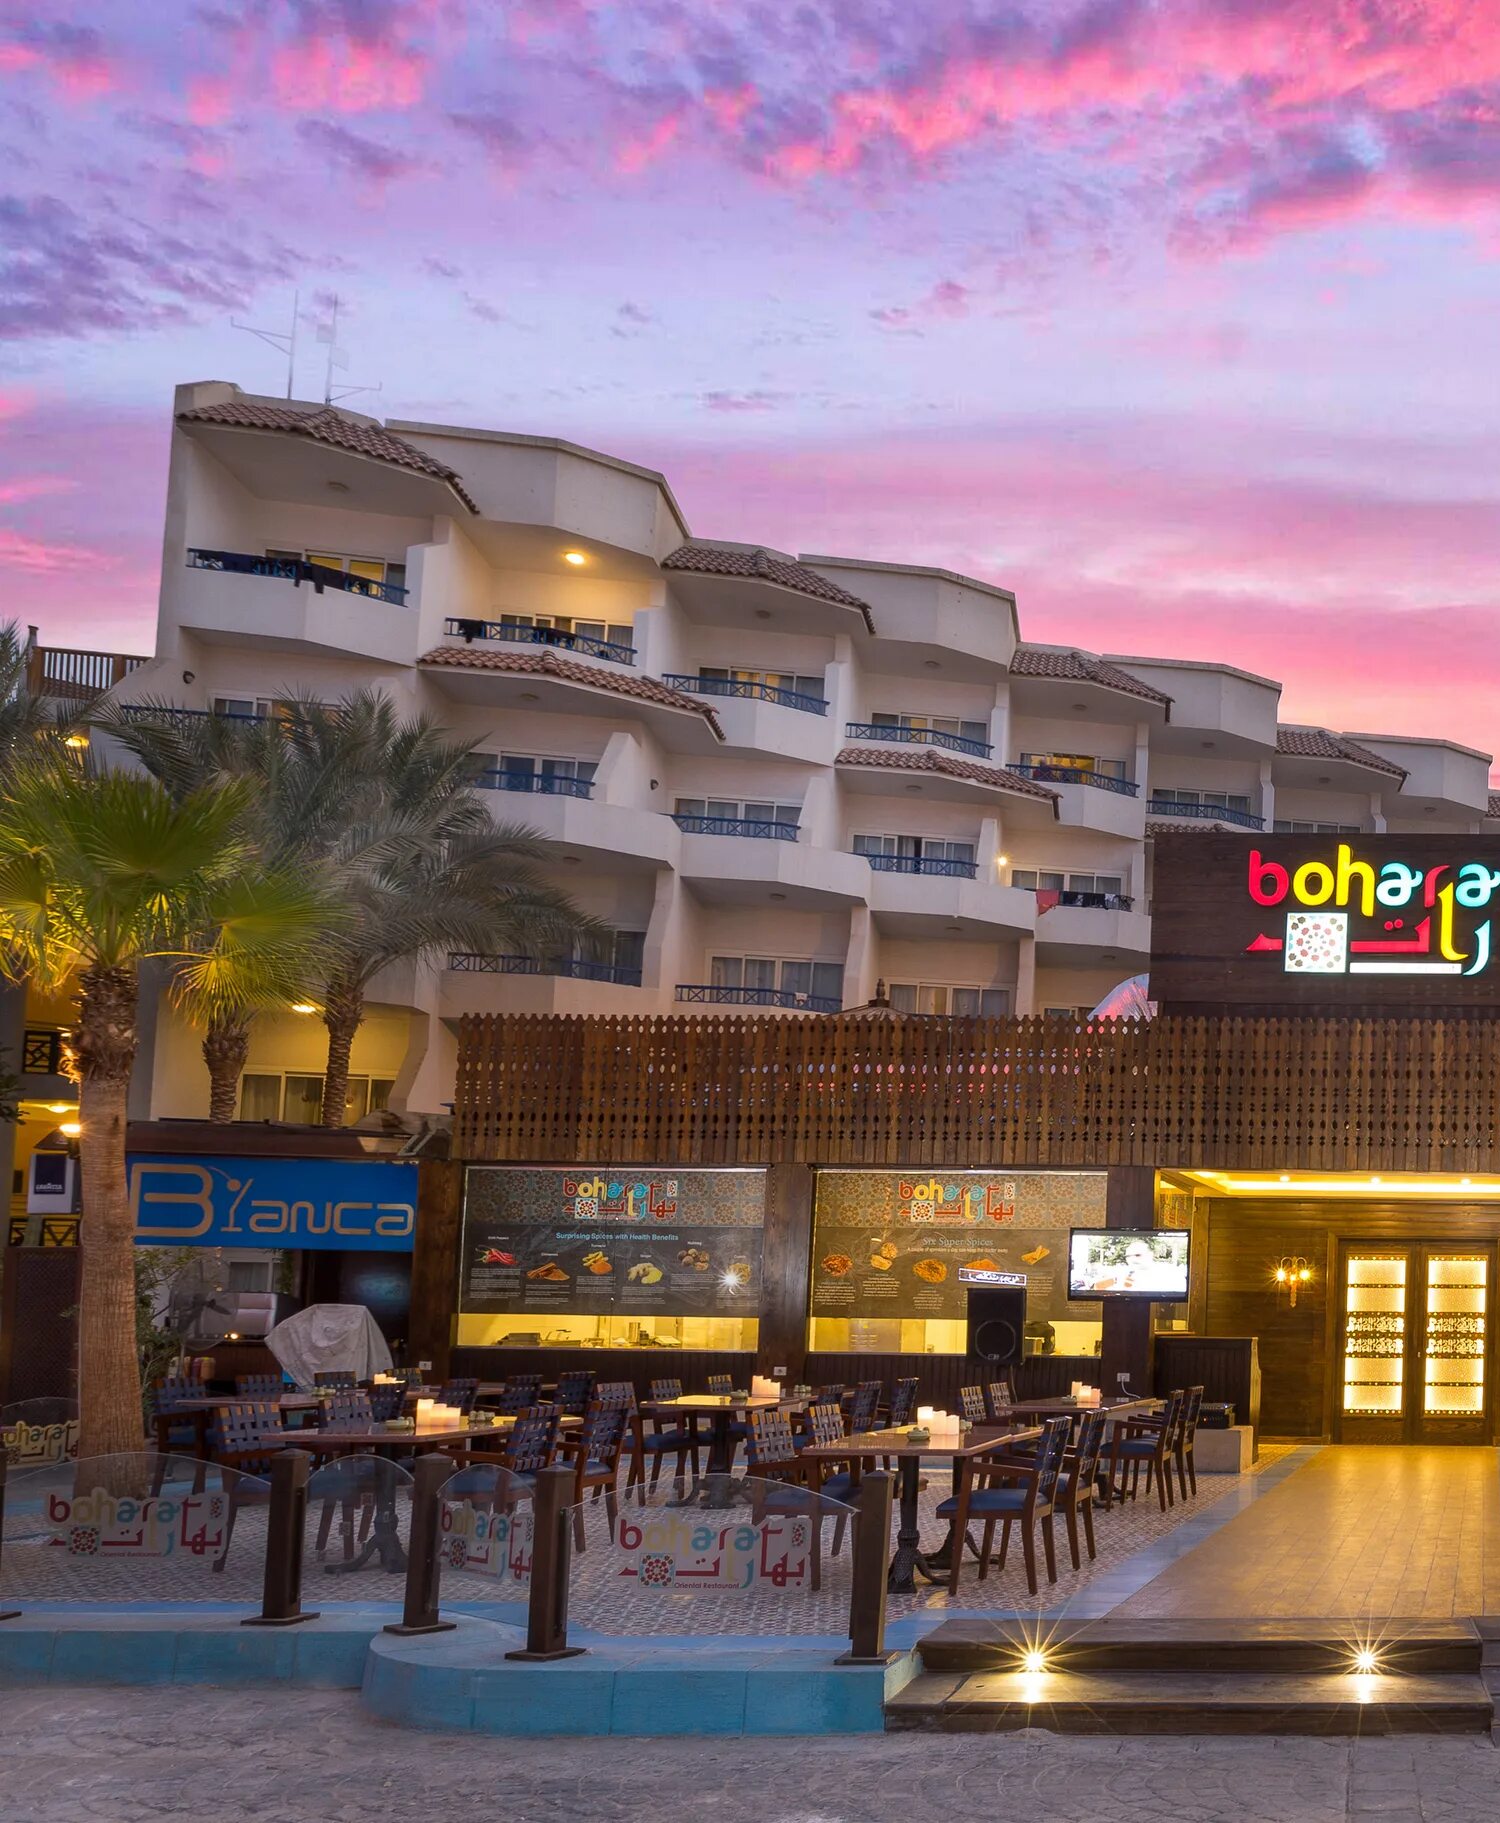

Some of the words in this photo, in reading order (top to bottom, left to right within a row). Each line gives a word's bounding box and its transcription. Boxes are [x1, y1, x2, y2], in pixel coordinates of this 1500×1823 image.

[556, 1232, 590, 1241] Surprising
[591, 1232, 613, 1241] Spices
[2, 1421, 77, 1446] oharat
[50, 1491, 201, 1526] boharat
[620, 1517, 783, 1557] boharat
